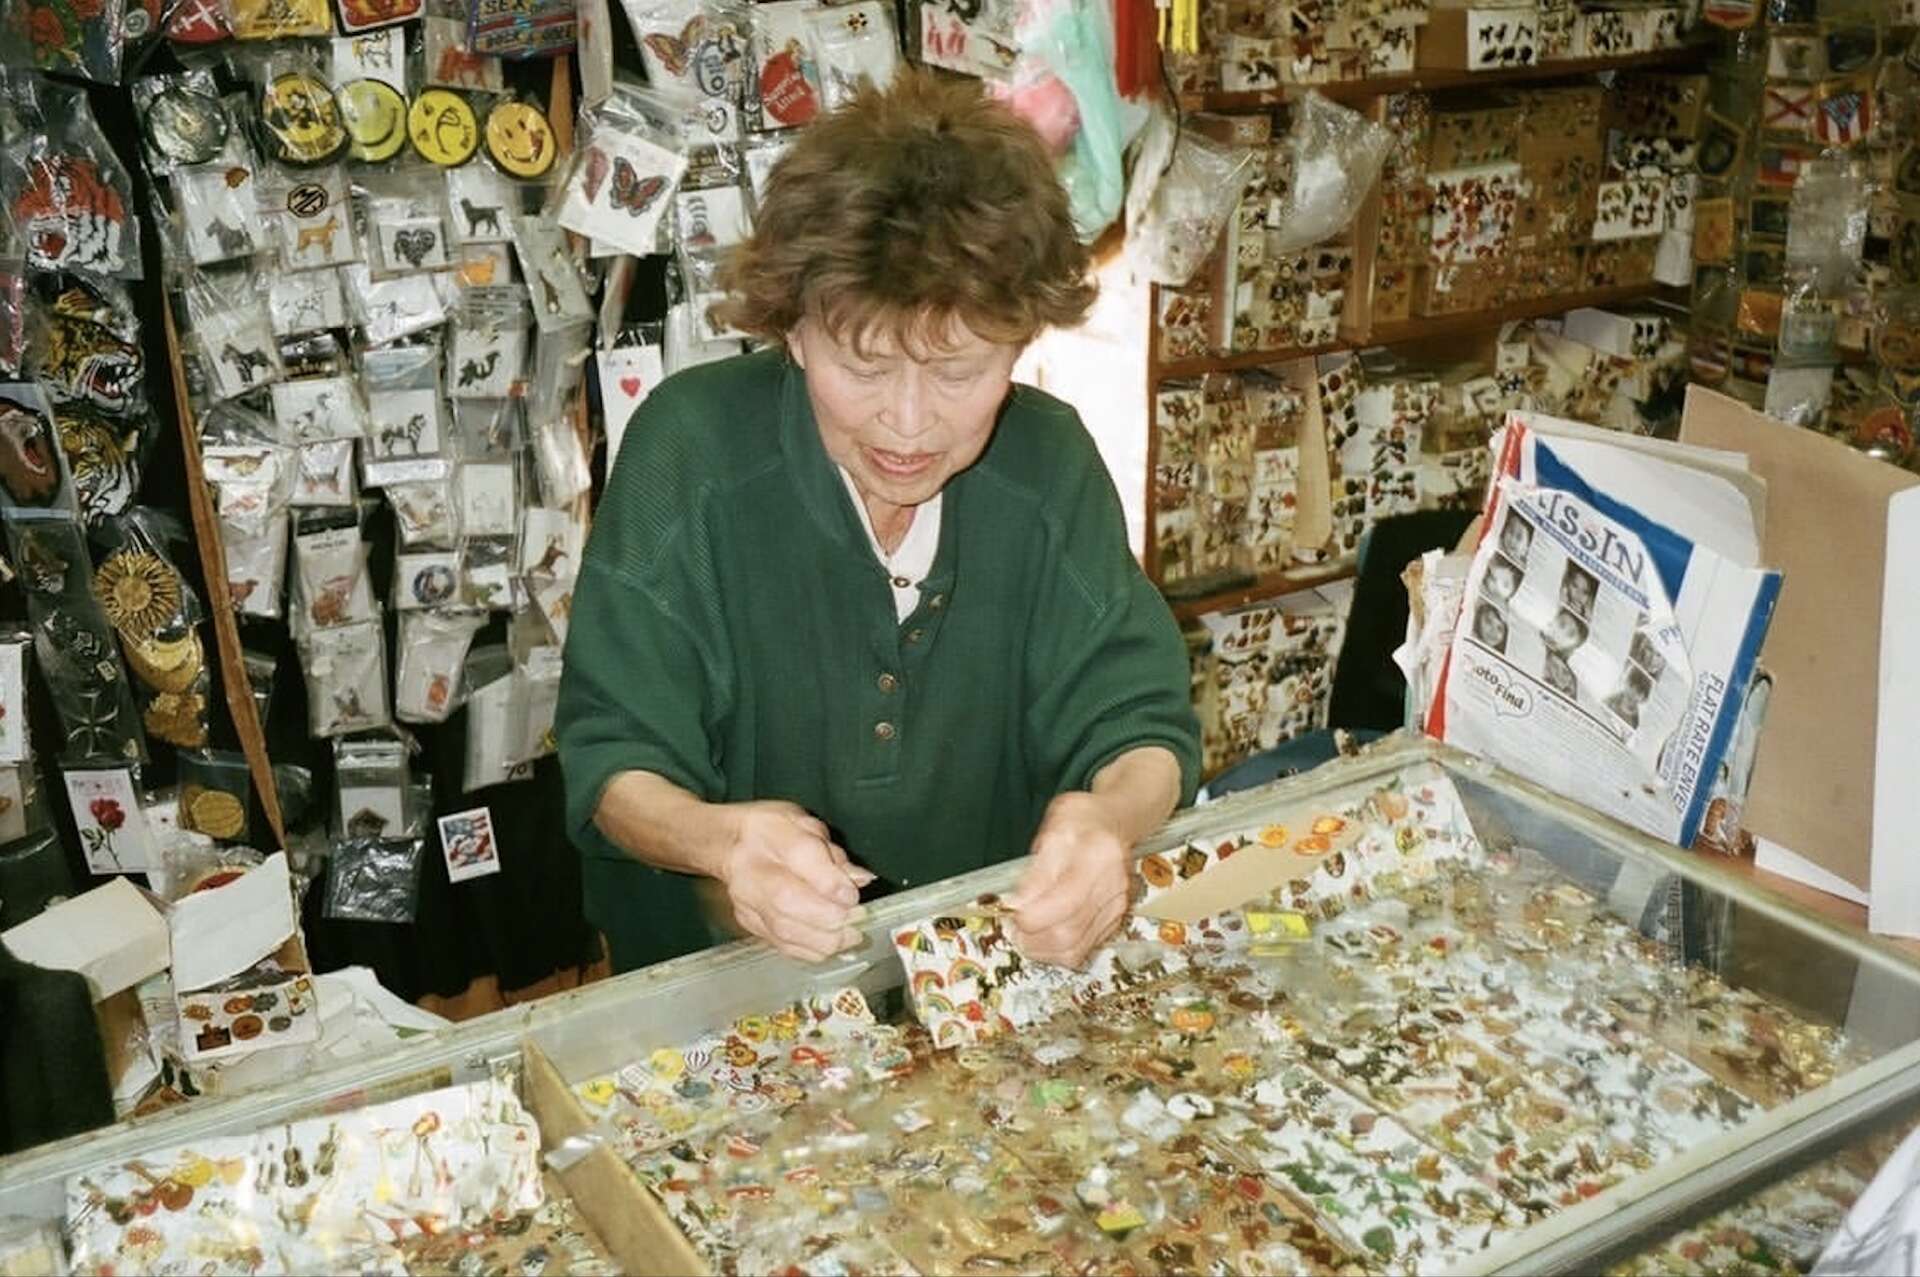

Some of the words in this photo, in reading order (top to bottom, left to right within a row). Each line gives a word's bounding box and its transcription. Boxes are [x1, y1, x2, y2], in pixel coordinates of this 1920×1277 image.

[1538, 493, 1645, 584] ISSIN
[1699, 672, 1726, 718] FLAT
[1686, 717, 1712, 765] RATE
